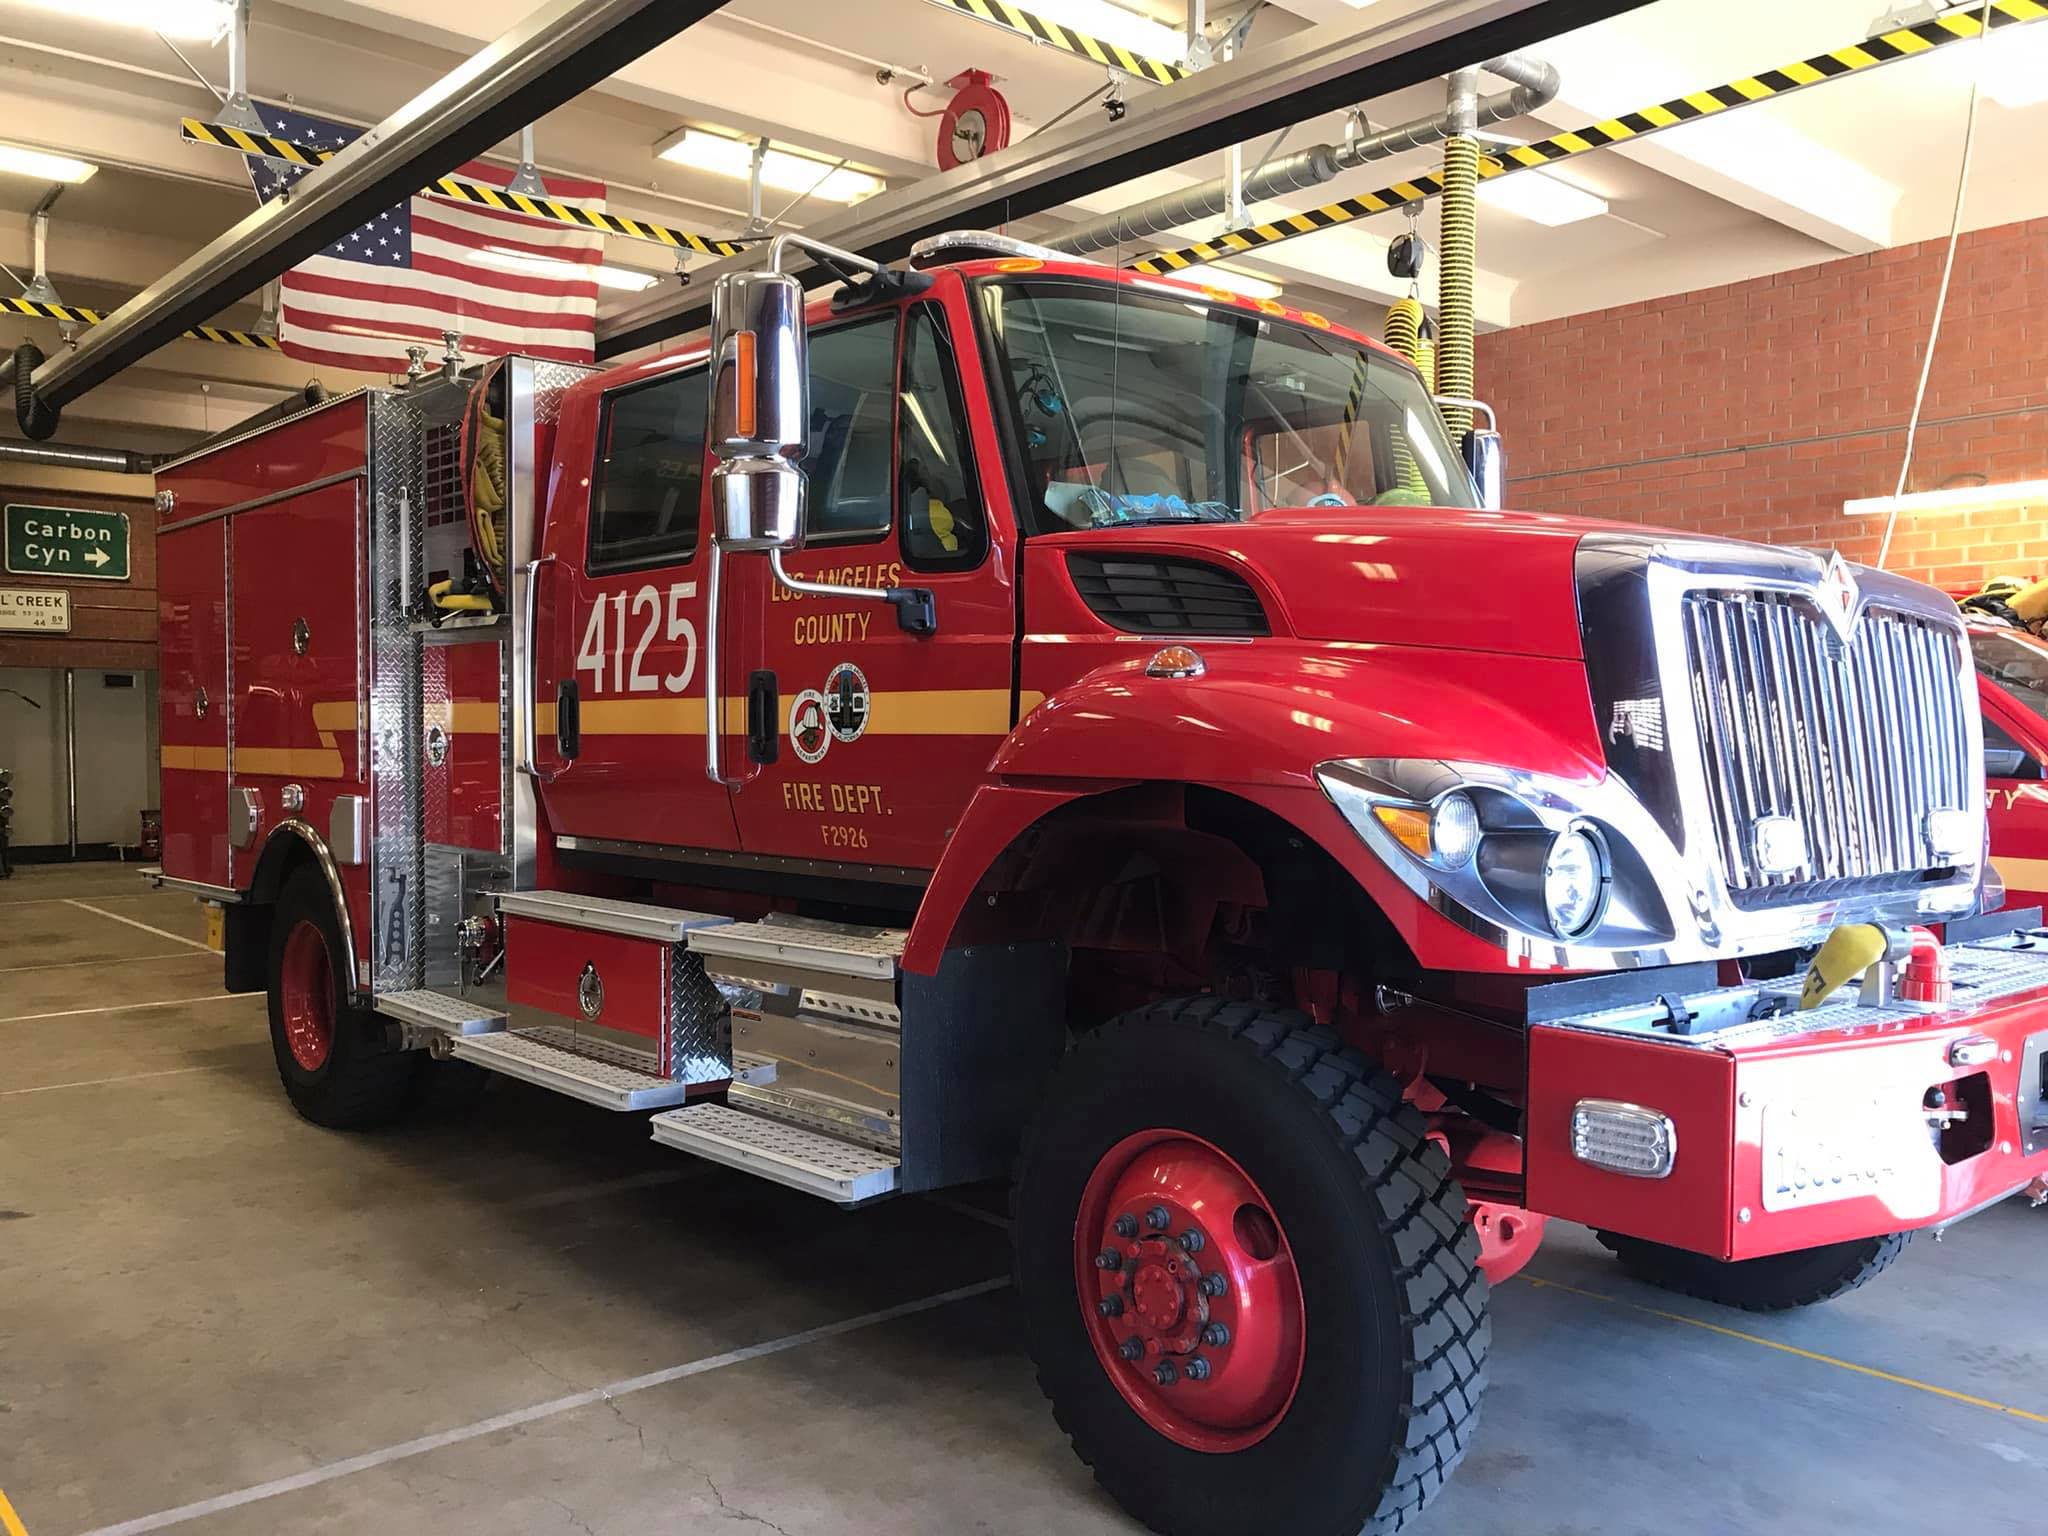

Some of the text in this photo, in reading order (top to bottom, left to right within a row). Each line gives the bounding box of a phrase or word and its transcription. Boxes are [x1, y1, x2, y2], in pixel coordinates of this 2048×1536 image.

[24, 519, 112, 541] Carbon
[24, 543, 71, 566] Cyn
[772, 562, 902, 602] LOS ANGELES
[15, 595, 63, 608] CREEK
[576, 581, 698, 694] 4125
[794, 612, 872, 645] COUNTY
[783, 782, 893, 815] FIRE DEPT.
[821, 825, 868, 849] F2926
